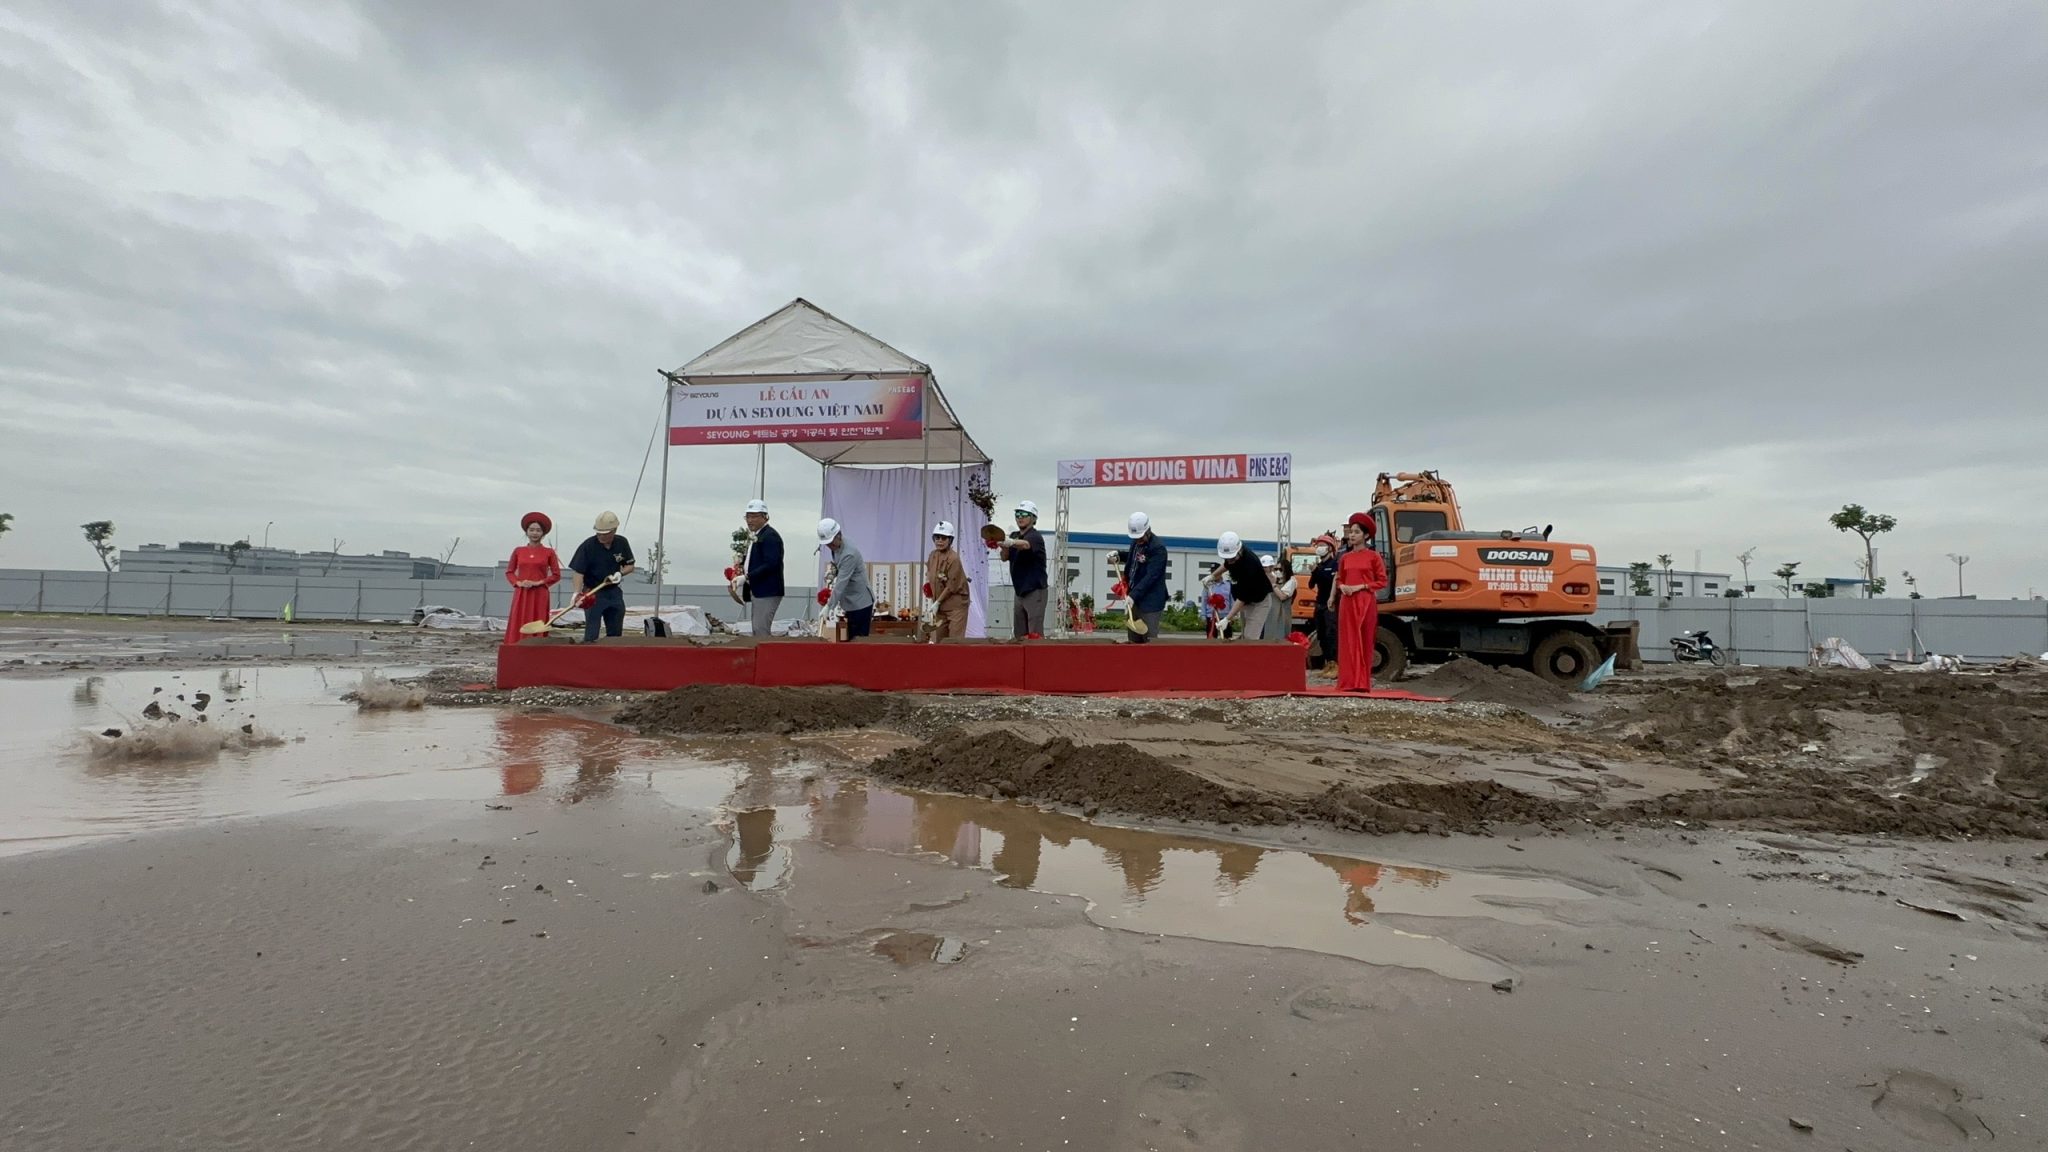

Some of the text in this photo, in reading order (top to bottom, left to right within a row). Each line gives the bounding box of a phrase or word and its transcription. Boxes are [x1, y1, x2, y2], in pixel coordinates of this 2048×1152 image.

[811, 388, 830, 400] AN
[706, 403, 884, 421] DỰ ÁN SEYOUNG VIỆT NAM
[706, 430, 750, 439] SEYOUNG
[1102, 457, 1239, 482] SEYOUNG VINA
[1249, 456, 1288, 477] PNS E&C
[1487, 550, 1549, 561] DOOSAN
[1479, 567, 1554, 583] MINH QUÂN
